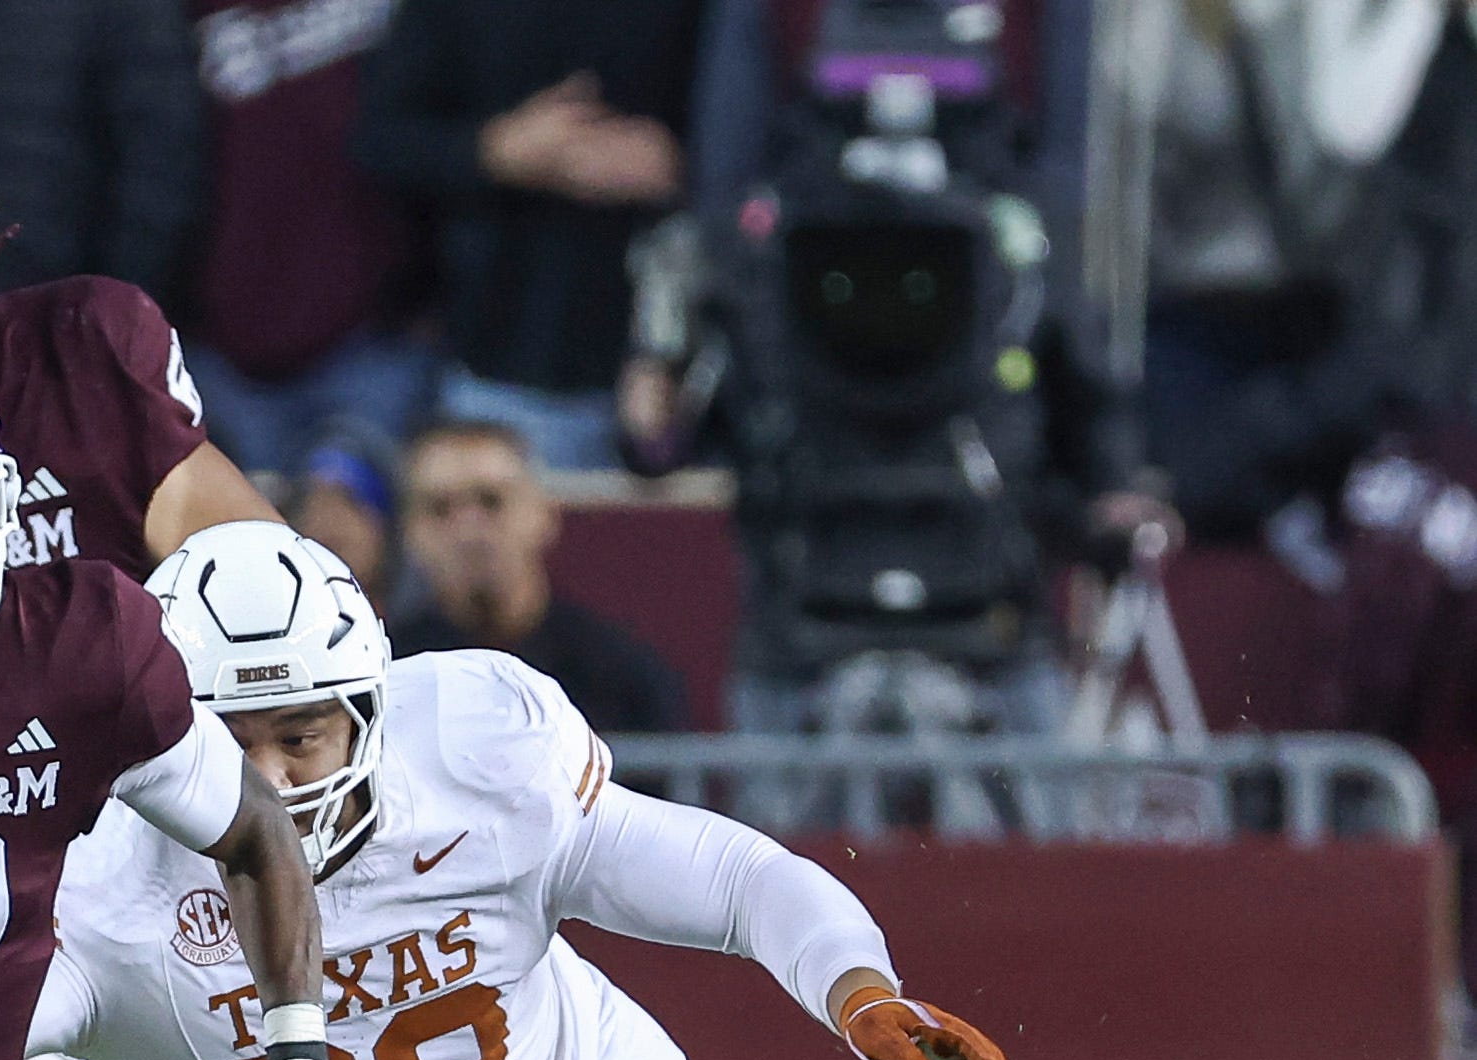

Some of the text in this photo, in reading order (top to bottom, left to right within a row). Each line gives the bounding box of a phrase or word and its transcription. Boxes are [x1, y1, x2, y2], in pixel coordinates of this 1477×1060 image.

[6, 506, 79, 567] &M
[179, 892, 230, 945] SEC
[209, 910, 478, 1051] TXAS
